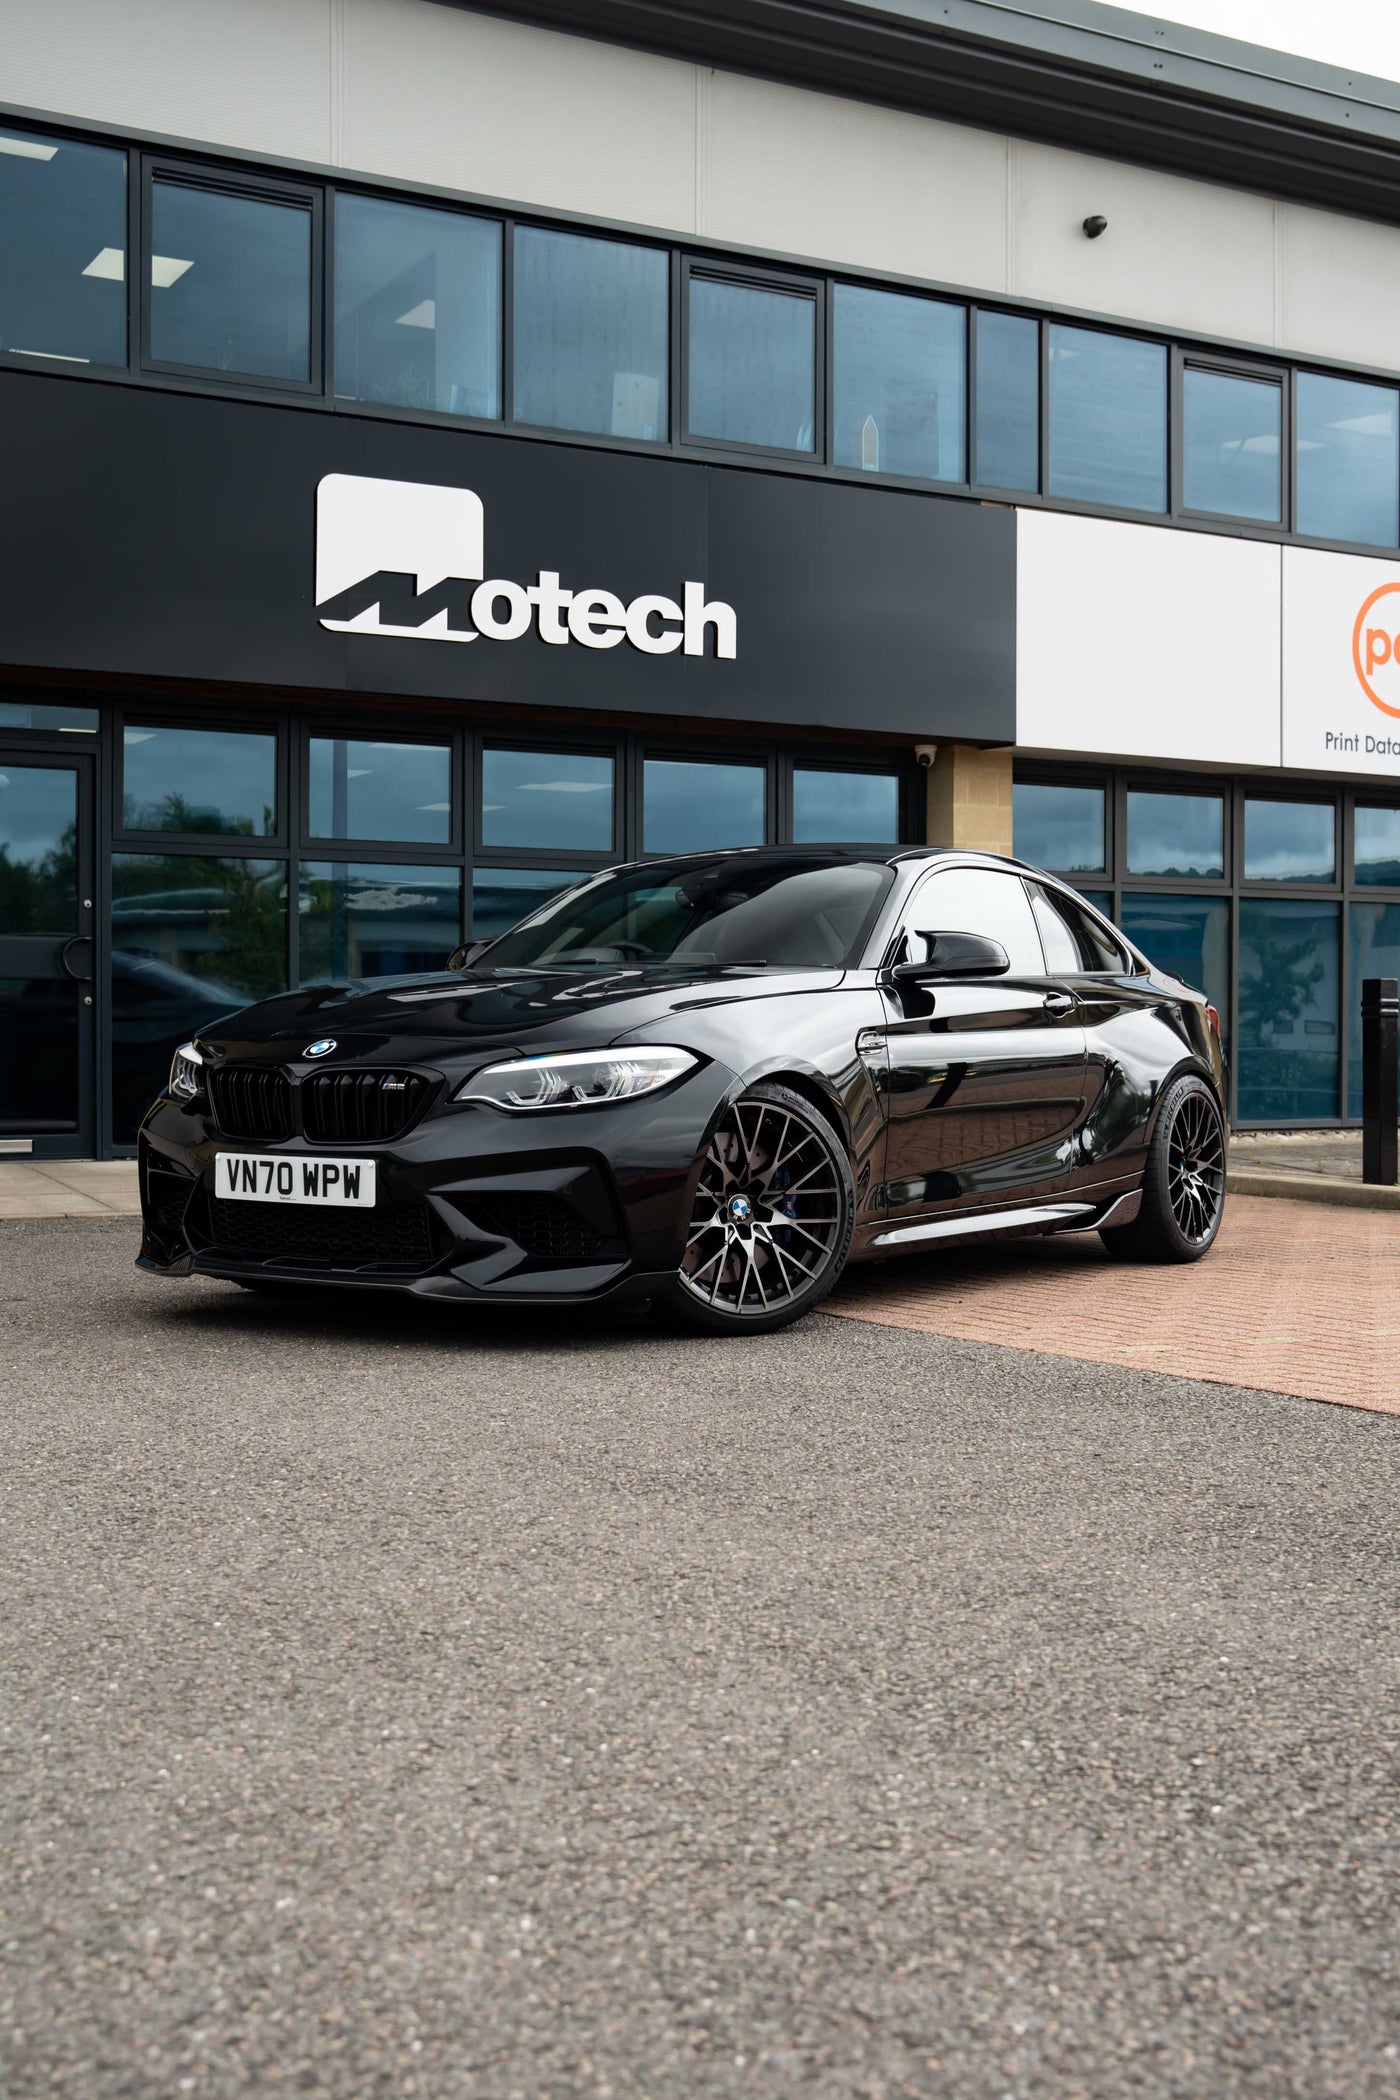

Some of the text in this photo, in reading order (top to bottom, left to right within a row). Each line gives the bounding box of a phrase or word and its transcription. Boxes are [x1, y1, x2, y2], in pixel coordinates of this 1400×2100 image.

[1366, 628, 1400, 675] p
[1326, 731, 1400, 756] Print Data
[227, 1159, 361, 1199] VN70 WPW
